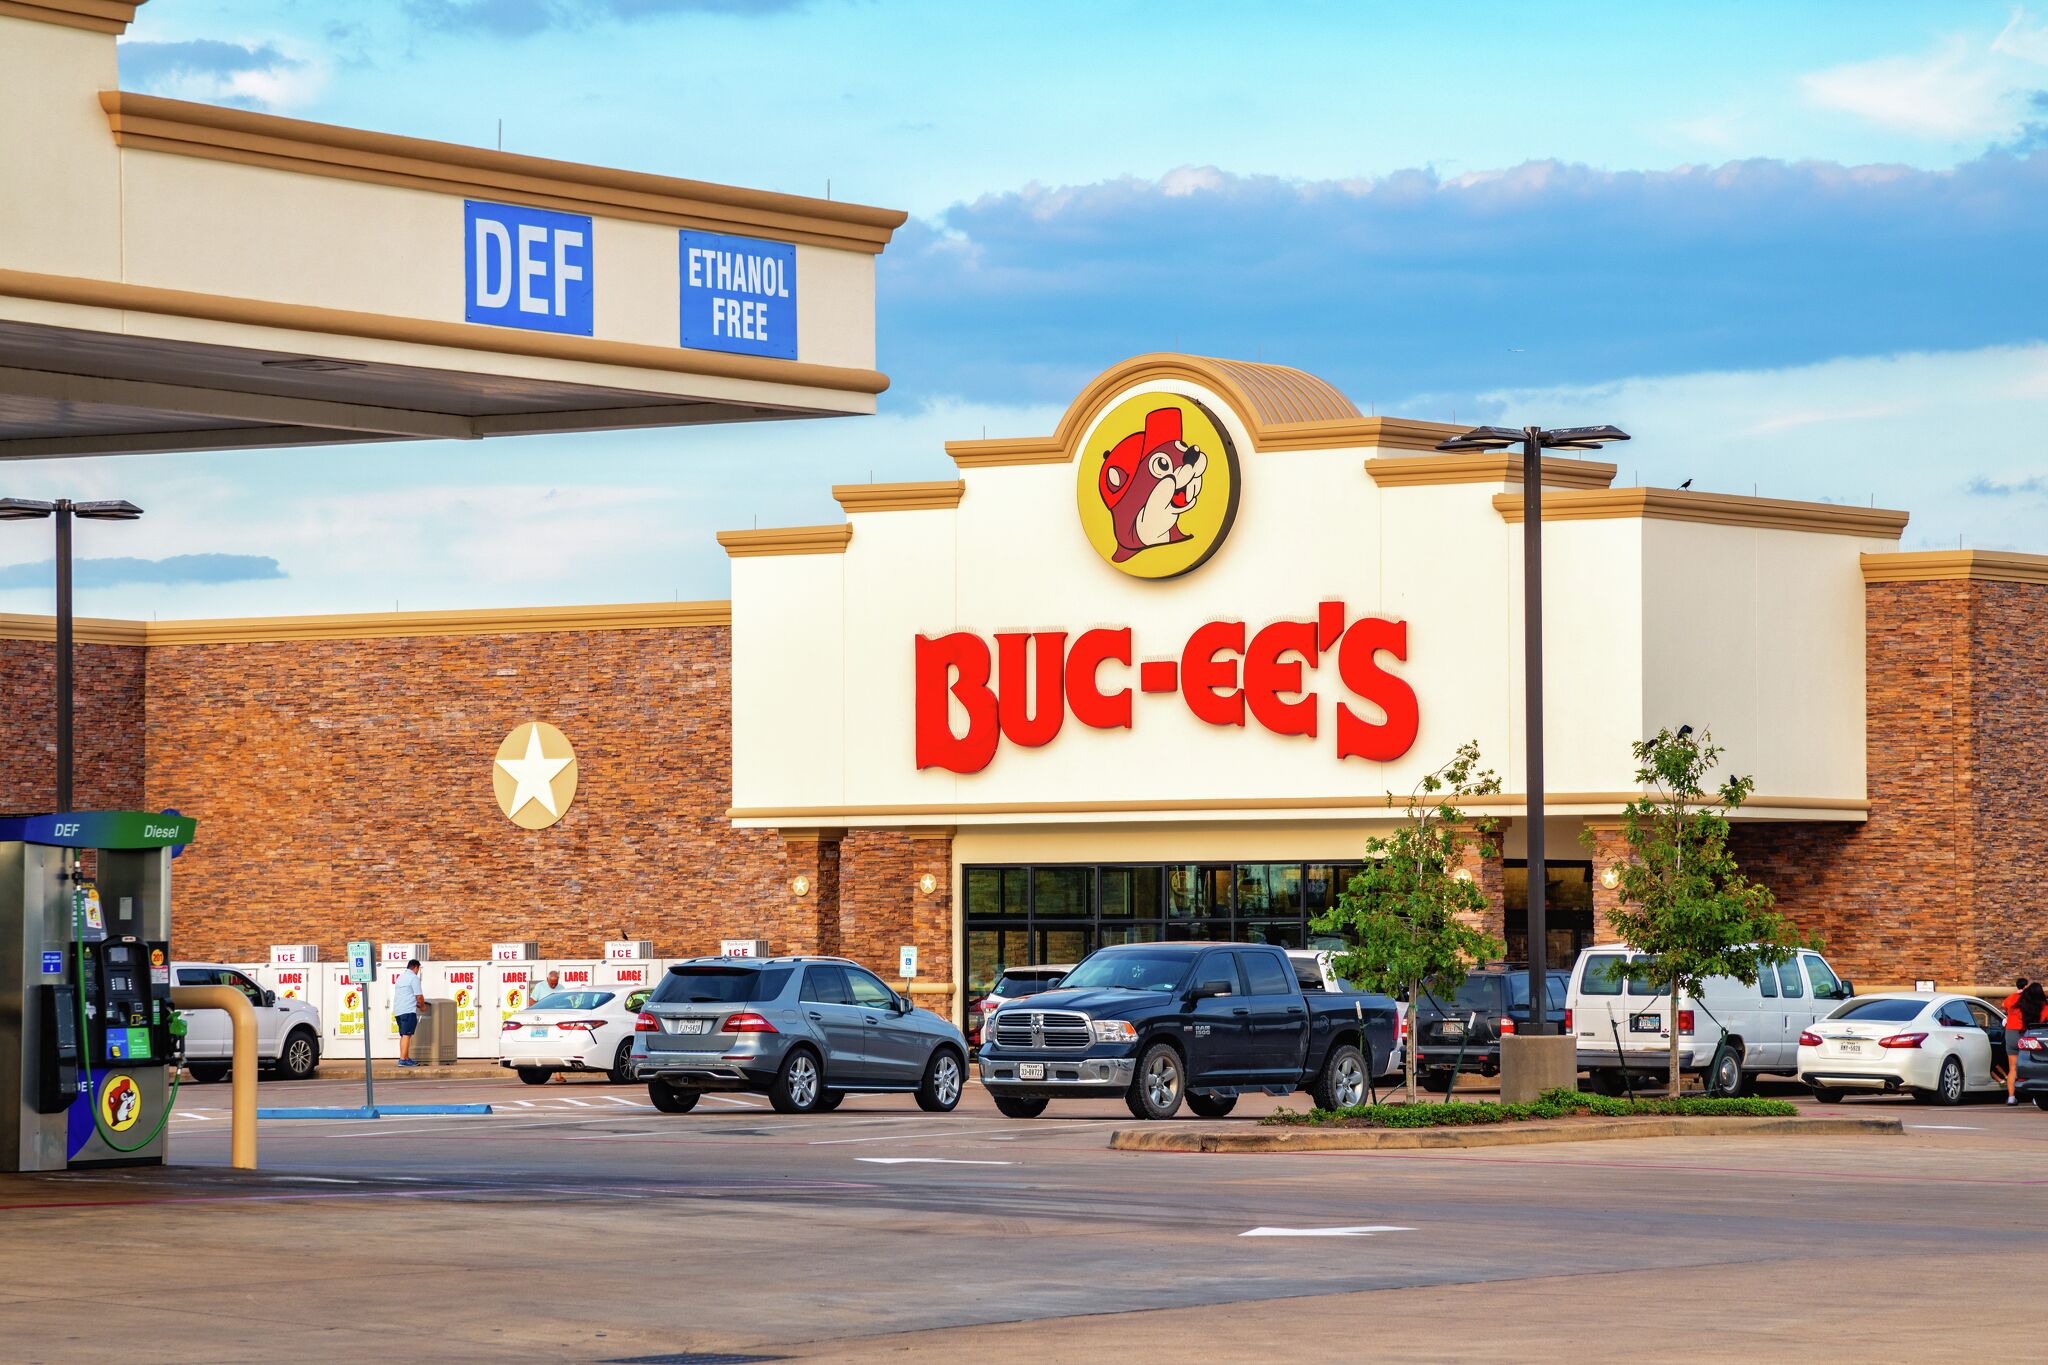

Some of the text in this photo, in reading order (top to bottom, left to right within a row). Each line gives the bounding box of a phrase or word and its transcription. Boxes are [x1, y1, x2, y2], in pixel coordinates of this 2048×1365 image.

[475, 218, 584, 316] DEF
[688, 247, 789, 298] ETHANOL
[712, 297, 768, 341] FREE
[914, 600, 1419, 774] BUC-EE'S
[54, 823, 80, 837] DEF
[144, 825, 179, 838] Diesel
[277, 953, 296, 962] ICE
[388, 951, 407, 960] ICE
[498, 950, 518, 959] ICE
[612, 949, 632, 958] ICE
[728, 948, 748, 957] ICE
[278, 973, 302, 984] LARGE
[450, 972, 474, 983] LARGE
[502, 972, 527, 983] LARGE
[564, 971, 588, 982] LARGE
[617, 970, 642, 981] LARGE
